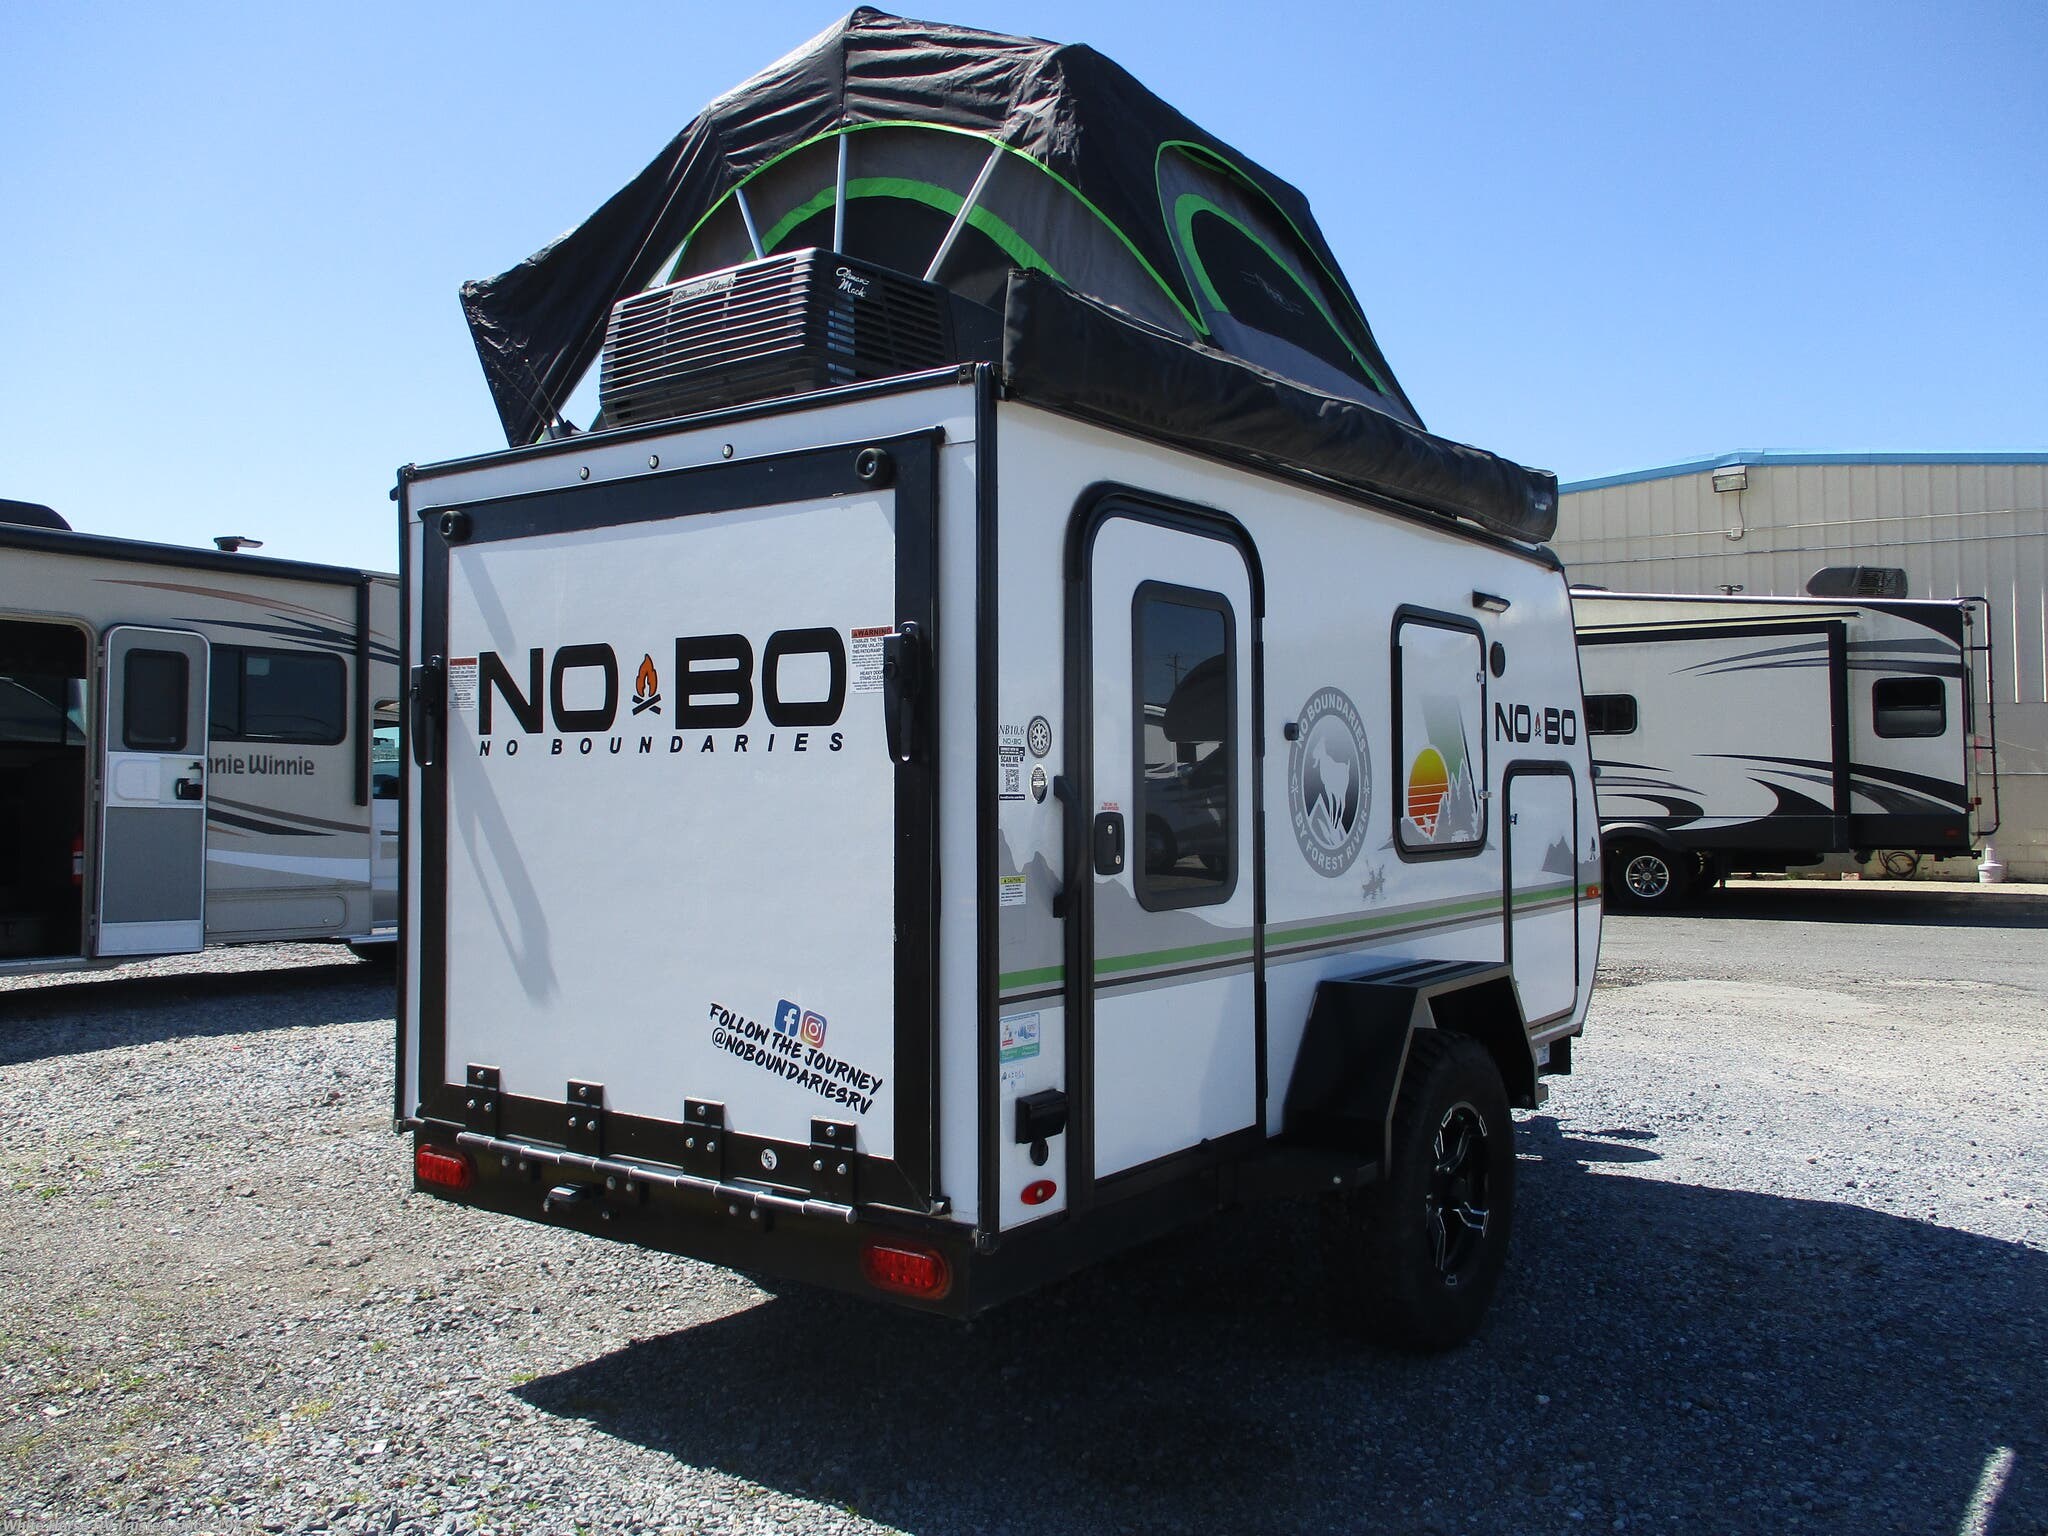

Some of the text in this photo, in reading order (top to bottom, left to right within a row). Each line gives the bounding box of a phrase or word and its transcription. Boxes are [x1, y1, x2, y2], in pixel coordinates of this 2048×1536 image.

[479, 627, 847, 735] NO BO
[479, 732, 844, 756] NO BOUNDARIES
[1296, 693, 1366, 753] NO BOUNDARIES
[1495, 702, 1577, 745] NO BO
[249, 754, 315, 775] Winnie
[1295, 811, 1367, 870] BY FOREST RIVER
[709, 1002, 883, 1095] FOLLOW THE JOURNEY
[712, 1027, 873, 1115] @NOBOUNDARIESRV
